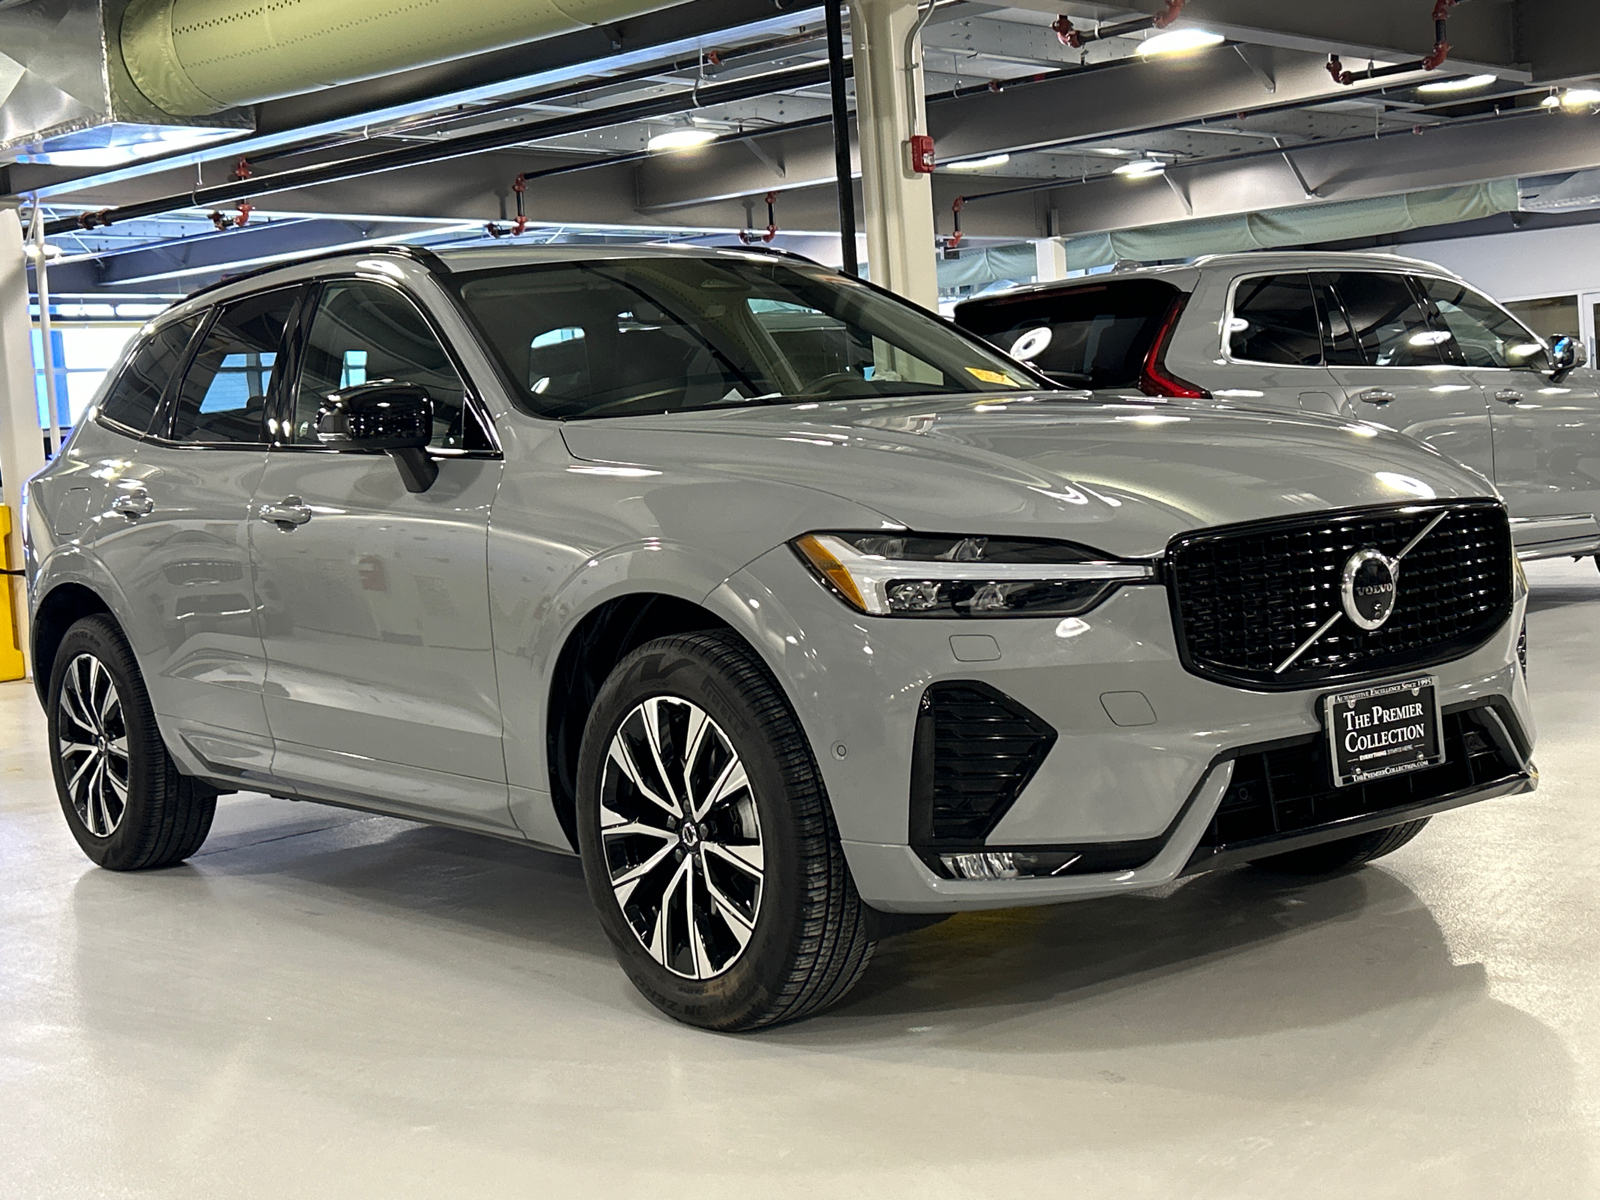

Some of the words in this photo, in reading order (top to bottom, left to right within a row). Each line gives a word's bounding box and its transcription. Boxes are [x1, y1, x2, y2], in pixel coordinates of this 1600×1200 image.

[1355, 583, 1393, 596] VOLVO
[1402, 681, 1417, 690] SINCE
[1343, 711, 1371, 730] THE
[1372, 703, 1423, 725] PREMIER
[1345, 723, 1424, 752] COLLECTION
